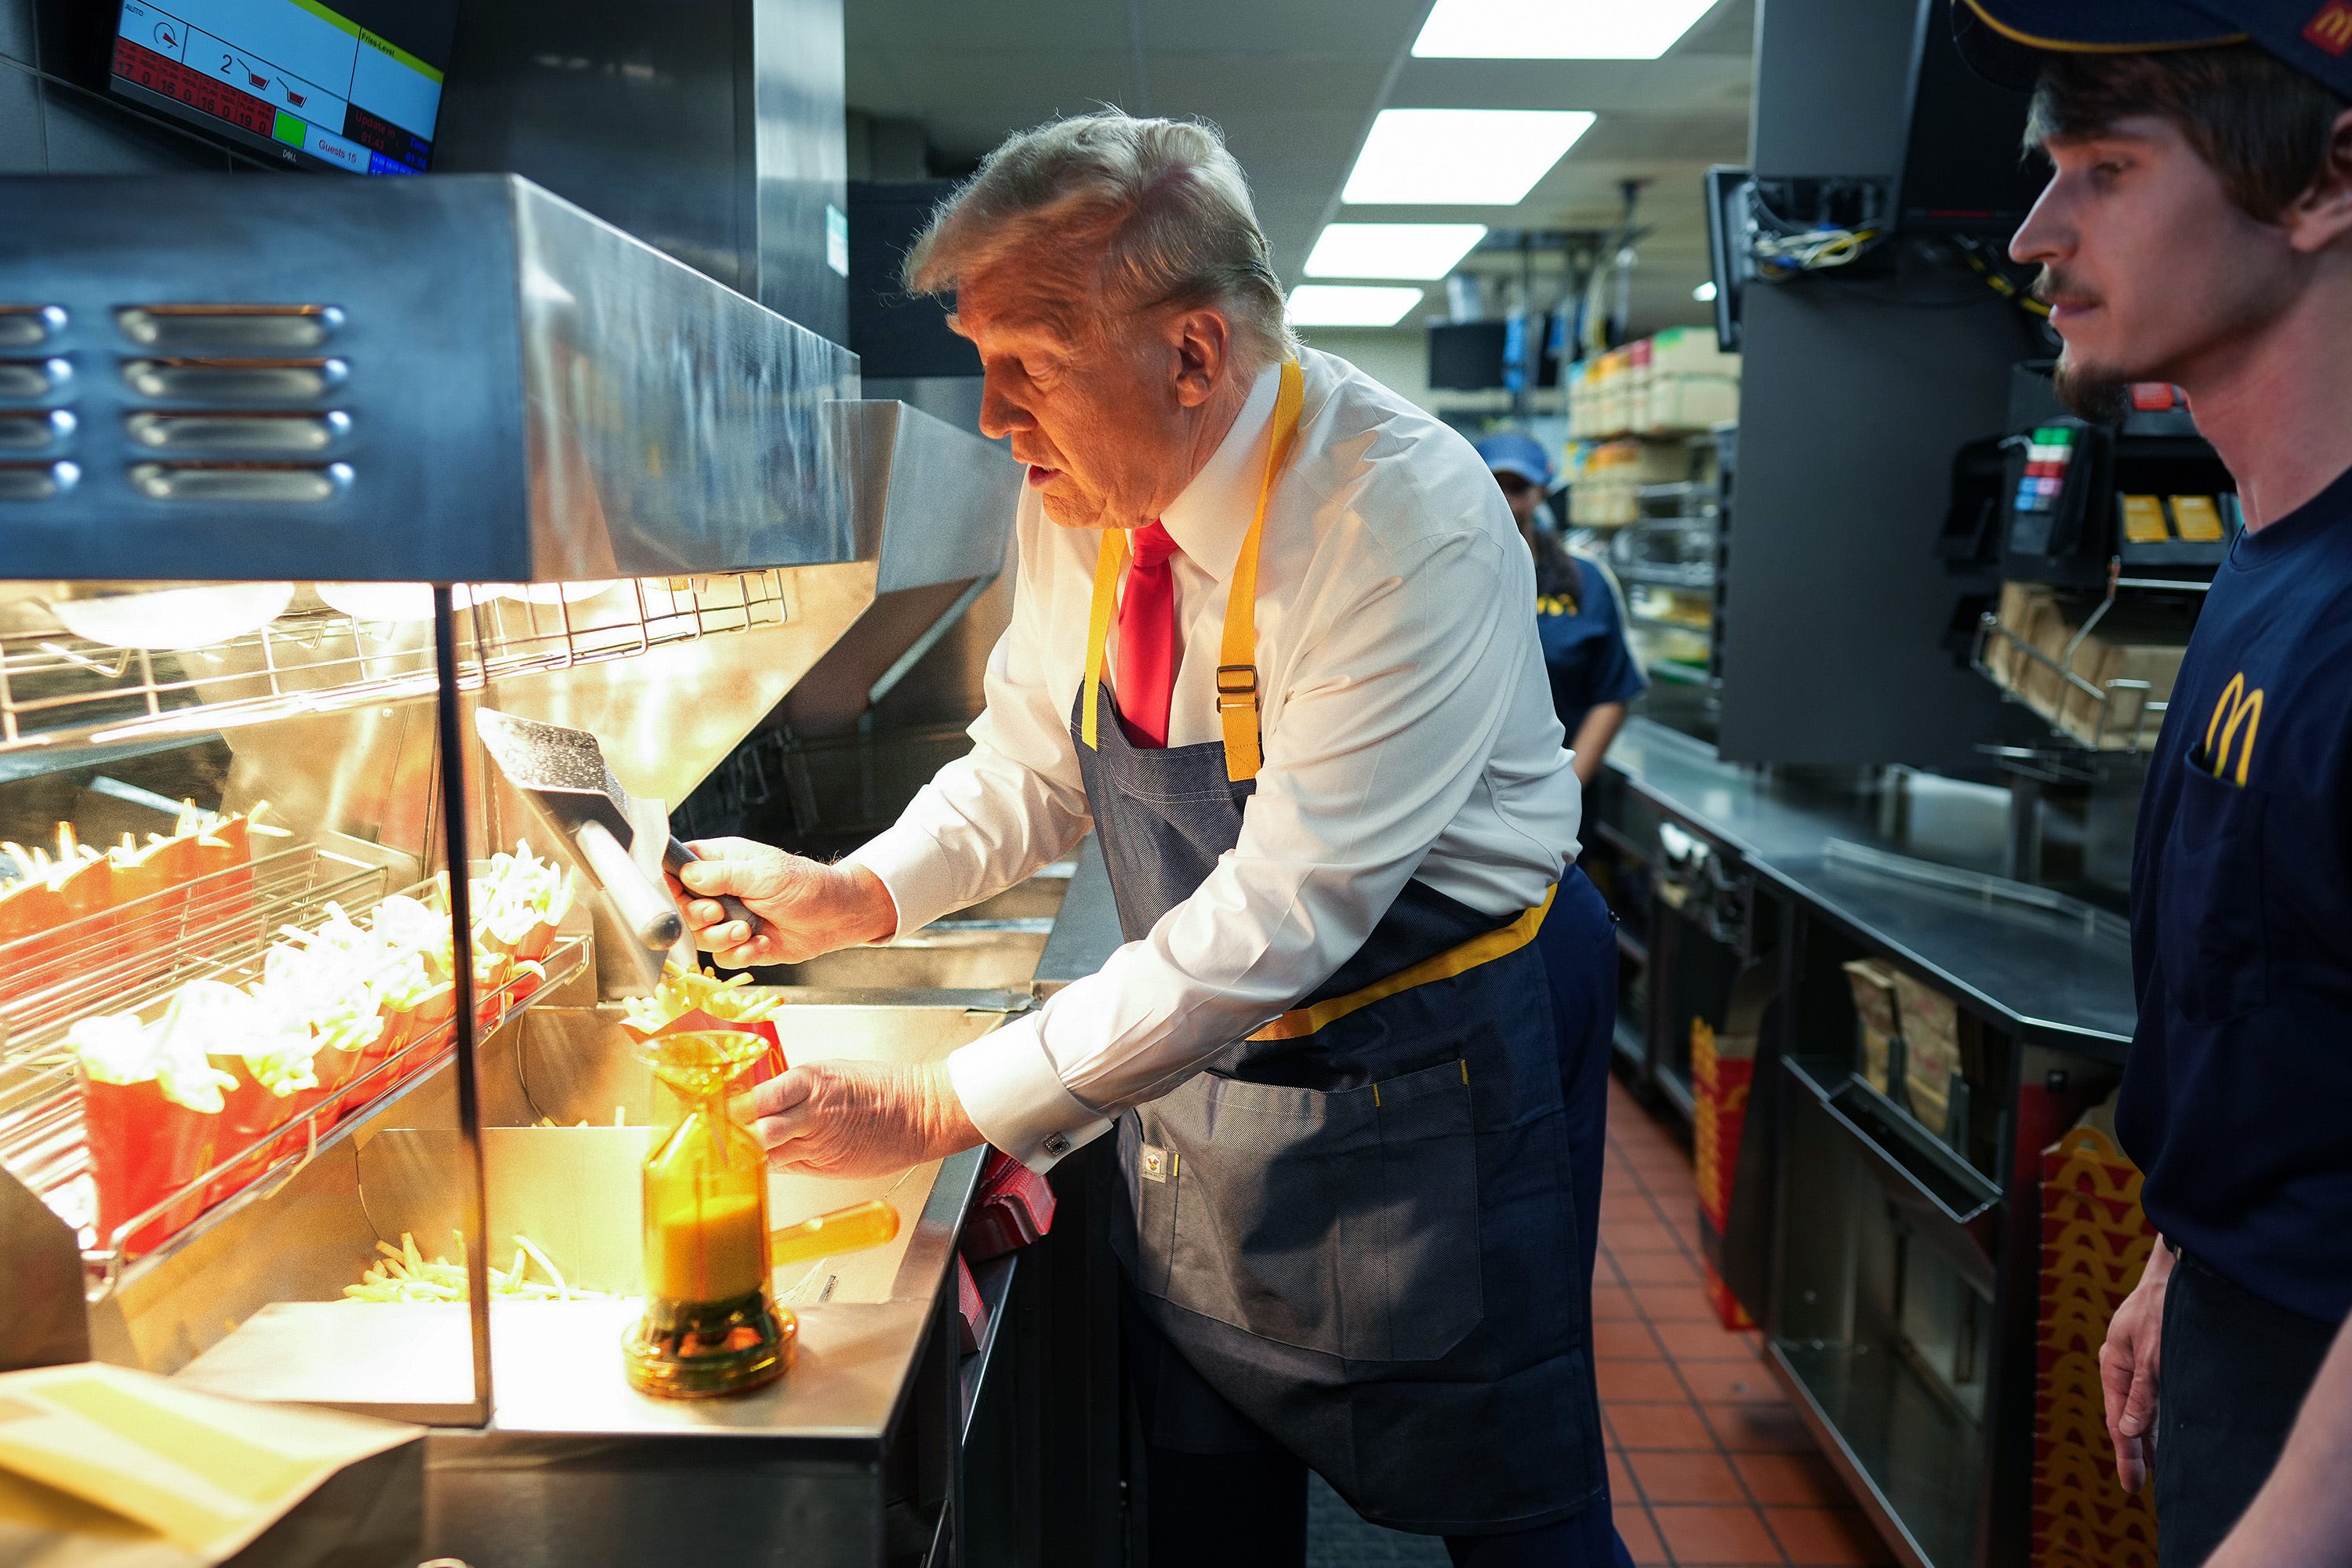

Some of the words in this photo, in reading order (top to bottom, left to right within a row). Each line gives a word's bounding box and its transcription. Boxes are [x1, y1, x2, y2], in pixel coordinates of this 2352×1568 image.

[125, 4, 144, 16] AUTO
[118, 61, 133, 76] 17
[142, 71, 151, 85] 0
[220, 54, 233, 74] 2
[183, 89, 191, 102] 0
[223, 105, 230, 118] 0
[240, 112, 252, 126] 19
[260, 121, 267, 133] 0
[356, 112, 386, 135] Update
[282, 149, 296, 163] DELL
[318, 139, 345, 159] Guests
